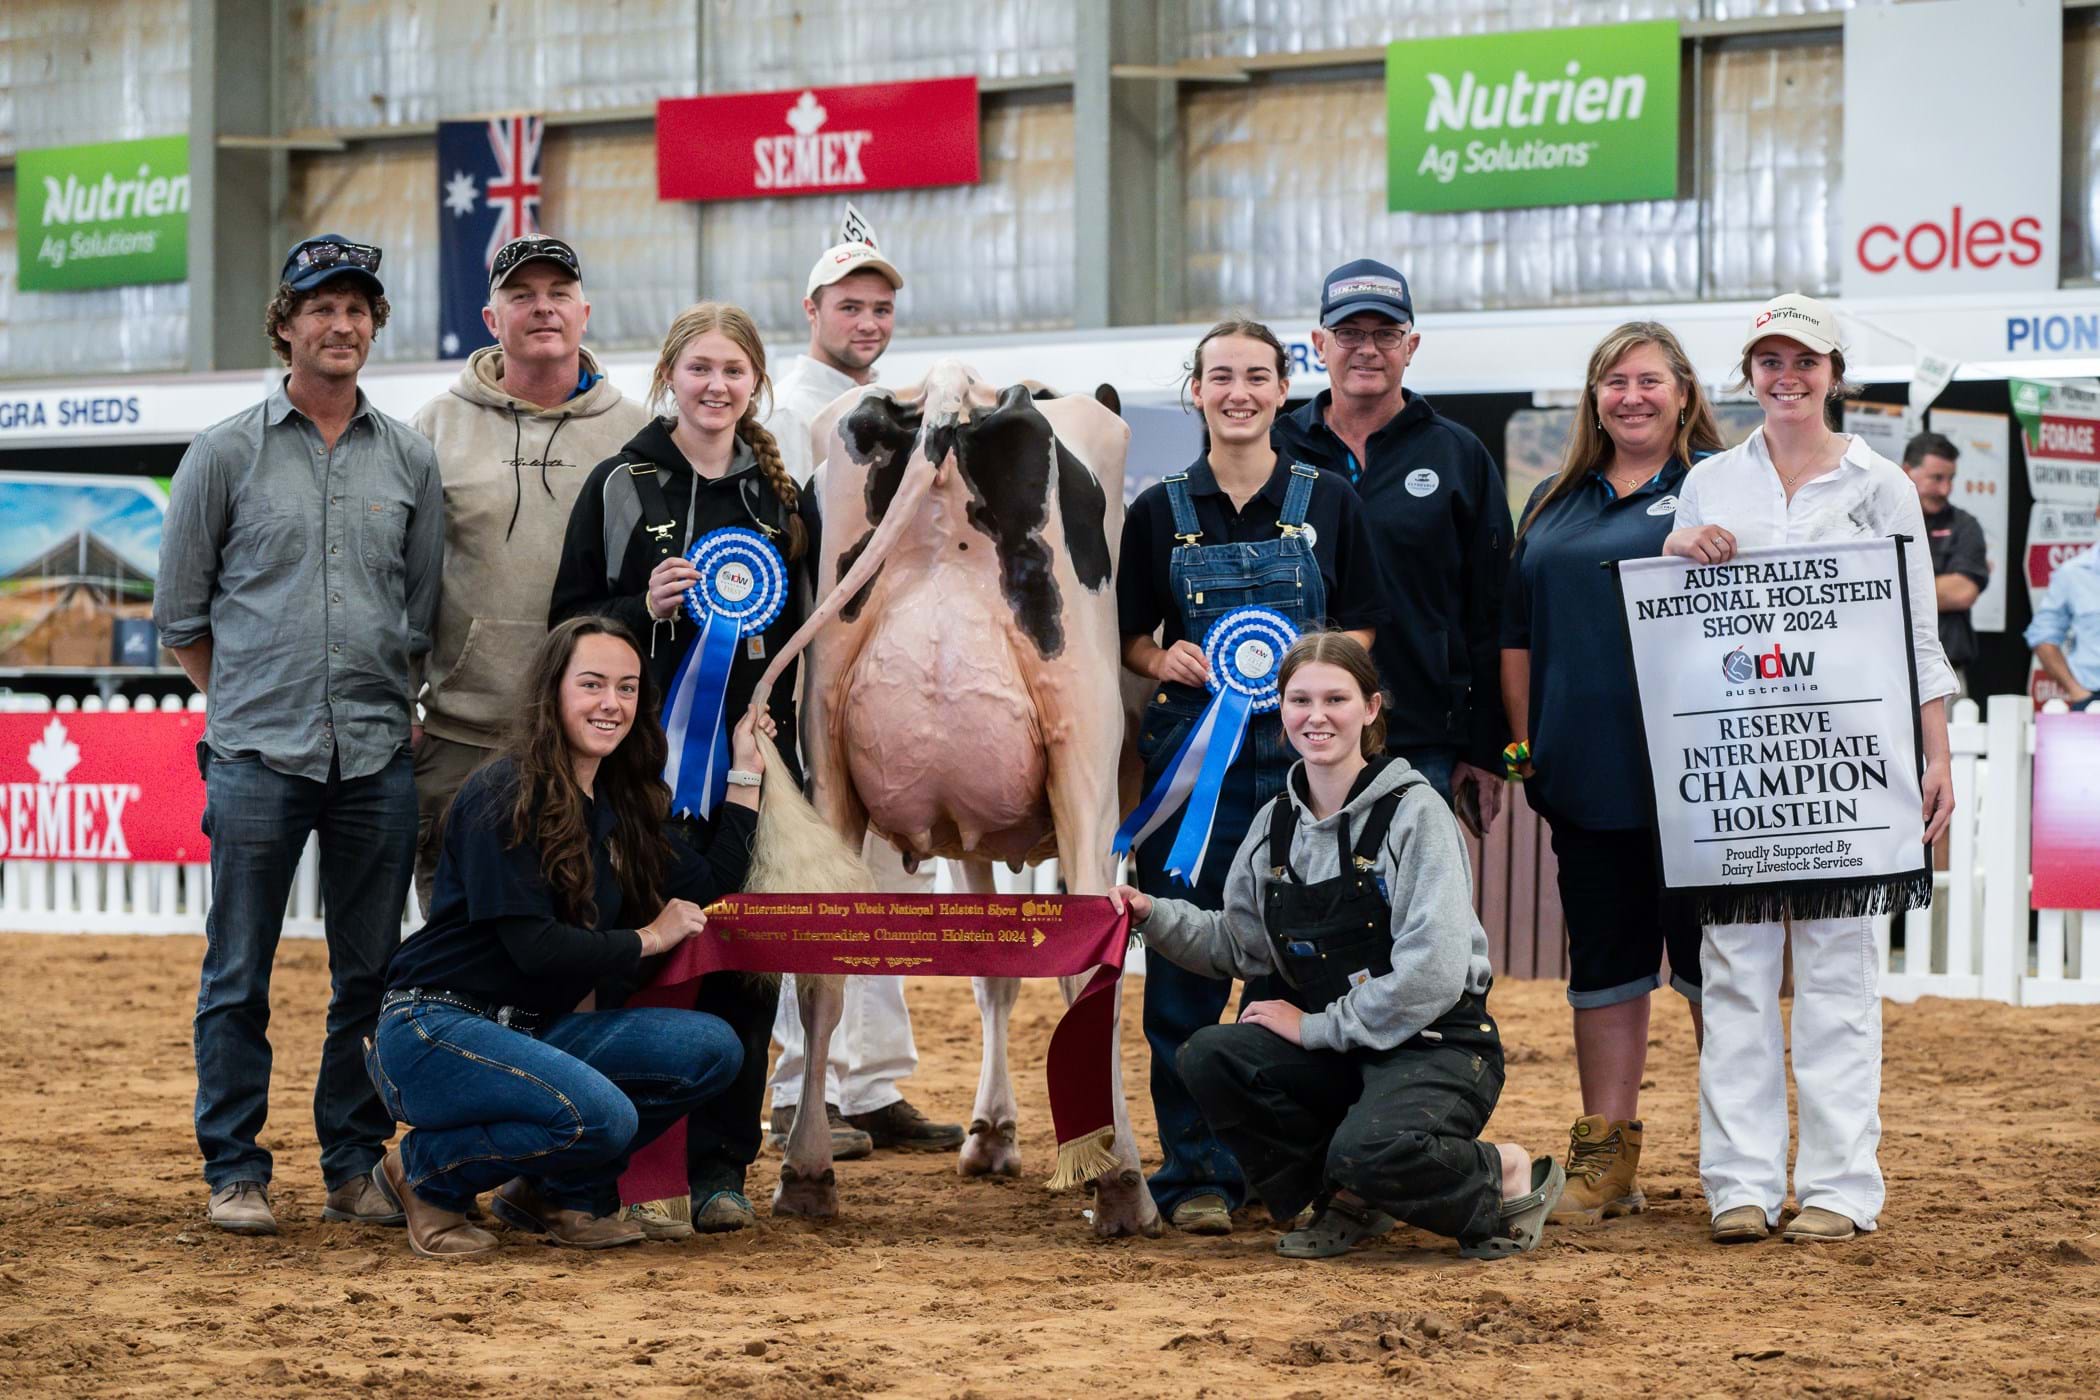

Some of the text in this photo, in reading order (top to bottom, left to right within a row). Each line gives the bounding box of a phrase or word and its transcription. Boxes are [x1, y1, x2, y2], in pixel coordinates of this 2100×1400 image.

[1425, 60, 1646, 132] Nutrien
[753, 130, 872, 189] SEMEX
[1417, 138, 1590, 183] Ag Solutions
[37, 229, 157, 269] Ag Solutions
[1856, 203, 2043, 274] coles
[58, 397, 140, 426] SHEDS
[2039, 422, 2096, 455] FORAGE
[1684, 558, 1839, 590] AUSTRALIA'S
[1636, 579, 1893, 621] NATIONAL HOLSTEIN
[1703, 609, 1838, 639] SHOW 2024
[1725, 683, 1819, 697] australia
[1718, 711, 1832, 741] RESERVE
[1682, 735, 1881, 770] INTERMEDIATE
[1679, 759, 1888, 804] CHAMPION
[1712, 799, 1858, 833] HOLSTEIN
[1726, 840, 1852, 860] Proudly Supported By
[1721, 856, 1863, 878] Dairy Livestock Services
[744, 902, 1018, 917] International Dairy Week National Holstein Show
[792, 929, 870, 942] Intermediate
[874, 928, 937, 943] Champion
[942, 930, 994, 942] Holstein
[998, 930, 1027, 942] 2024
